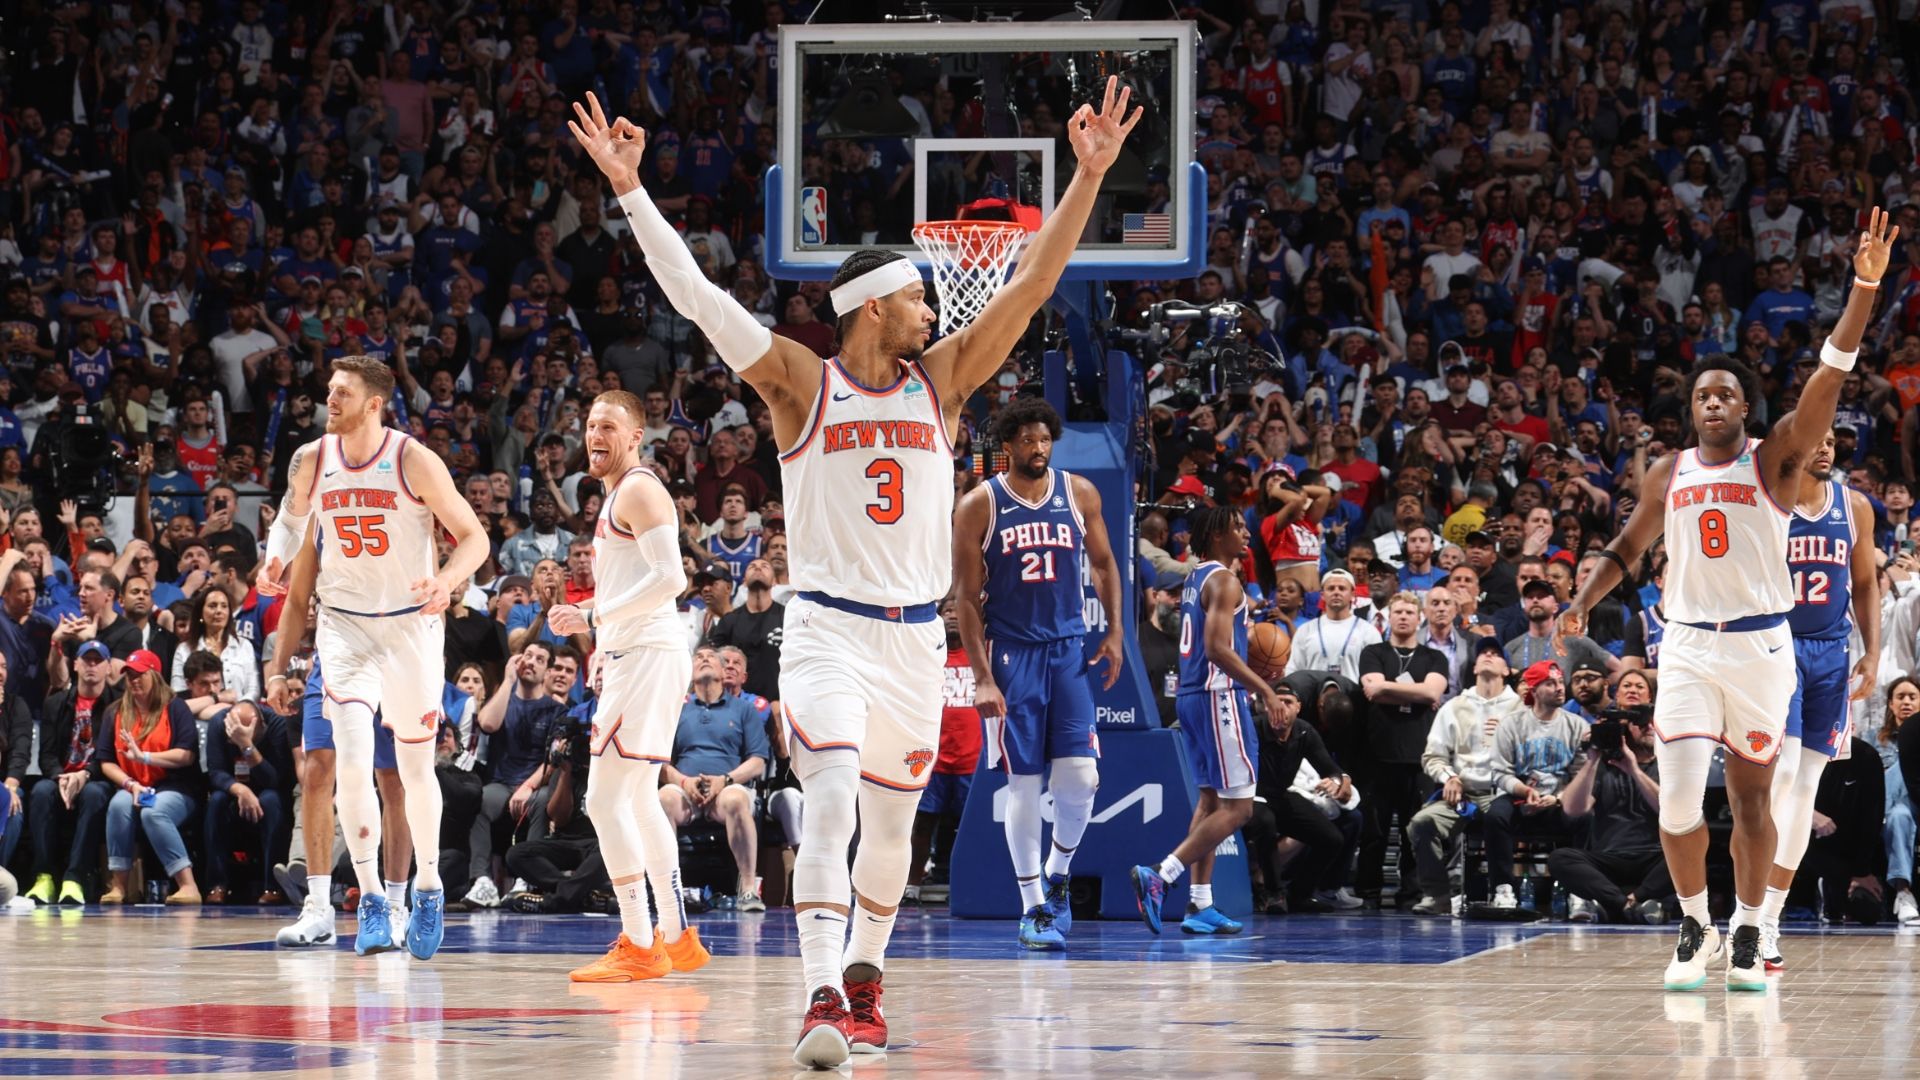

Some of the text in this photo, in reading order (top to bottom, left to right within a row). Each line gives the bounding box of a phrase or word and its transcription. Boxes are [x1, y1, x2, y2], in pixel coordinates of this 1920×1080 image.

[804, 231, 818, 242] NBA
[1643, 317, 1653, 335] 0
[86, 374, 96, 388] 0
[823, 420, 937, 456] NEW YORK
[321, 487, 398, 512] NEW YORK
[865, 458, 904, 525] 3
[1672, 482, 1758, 512] NEW YORK
[333, 514, 390, 558] 55
[1000, 522, 1074, 554] PHILA
[1698, 508, 1730, 559] 8
[1021, 550, 1057, 583] 21
[1788, 535, 1848, 567] HILA
[1793, 571, 1831, 604] 12
[942, 679, 977, 698] OVE
[1096, 706, 1135, 723] Pixel
